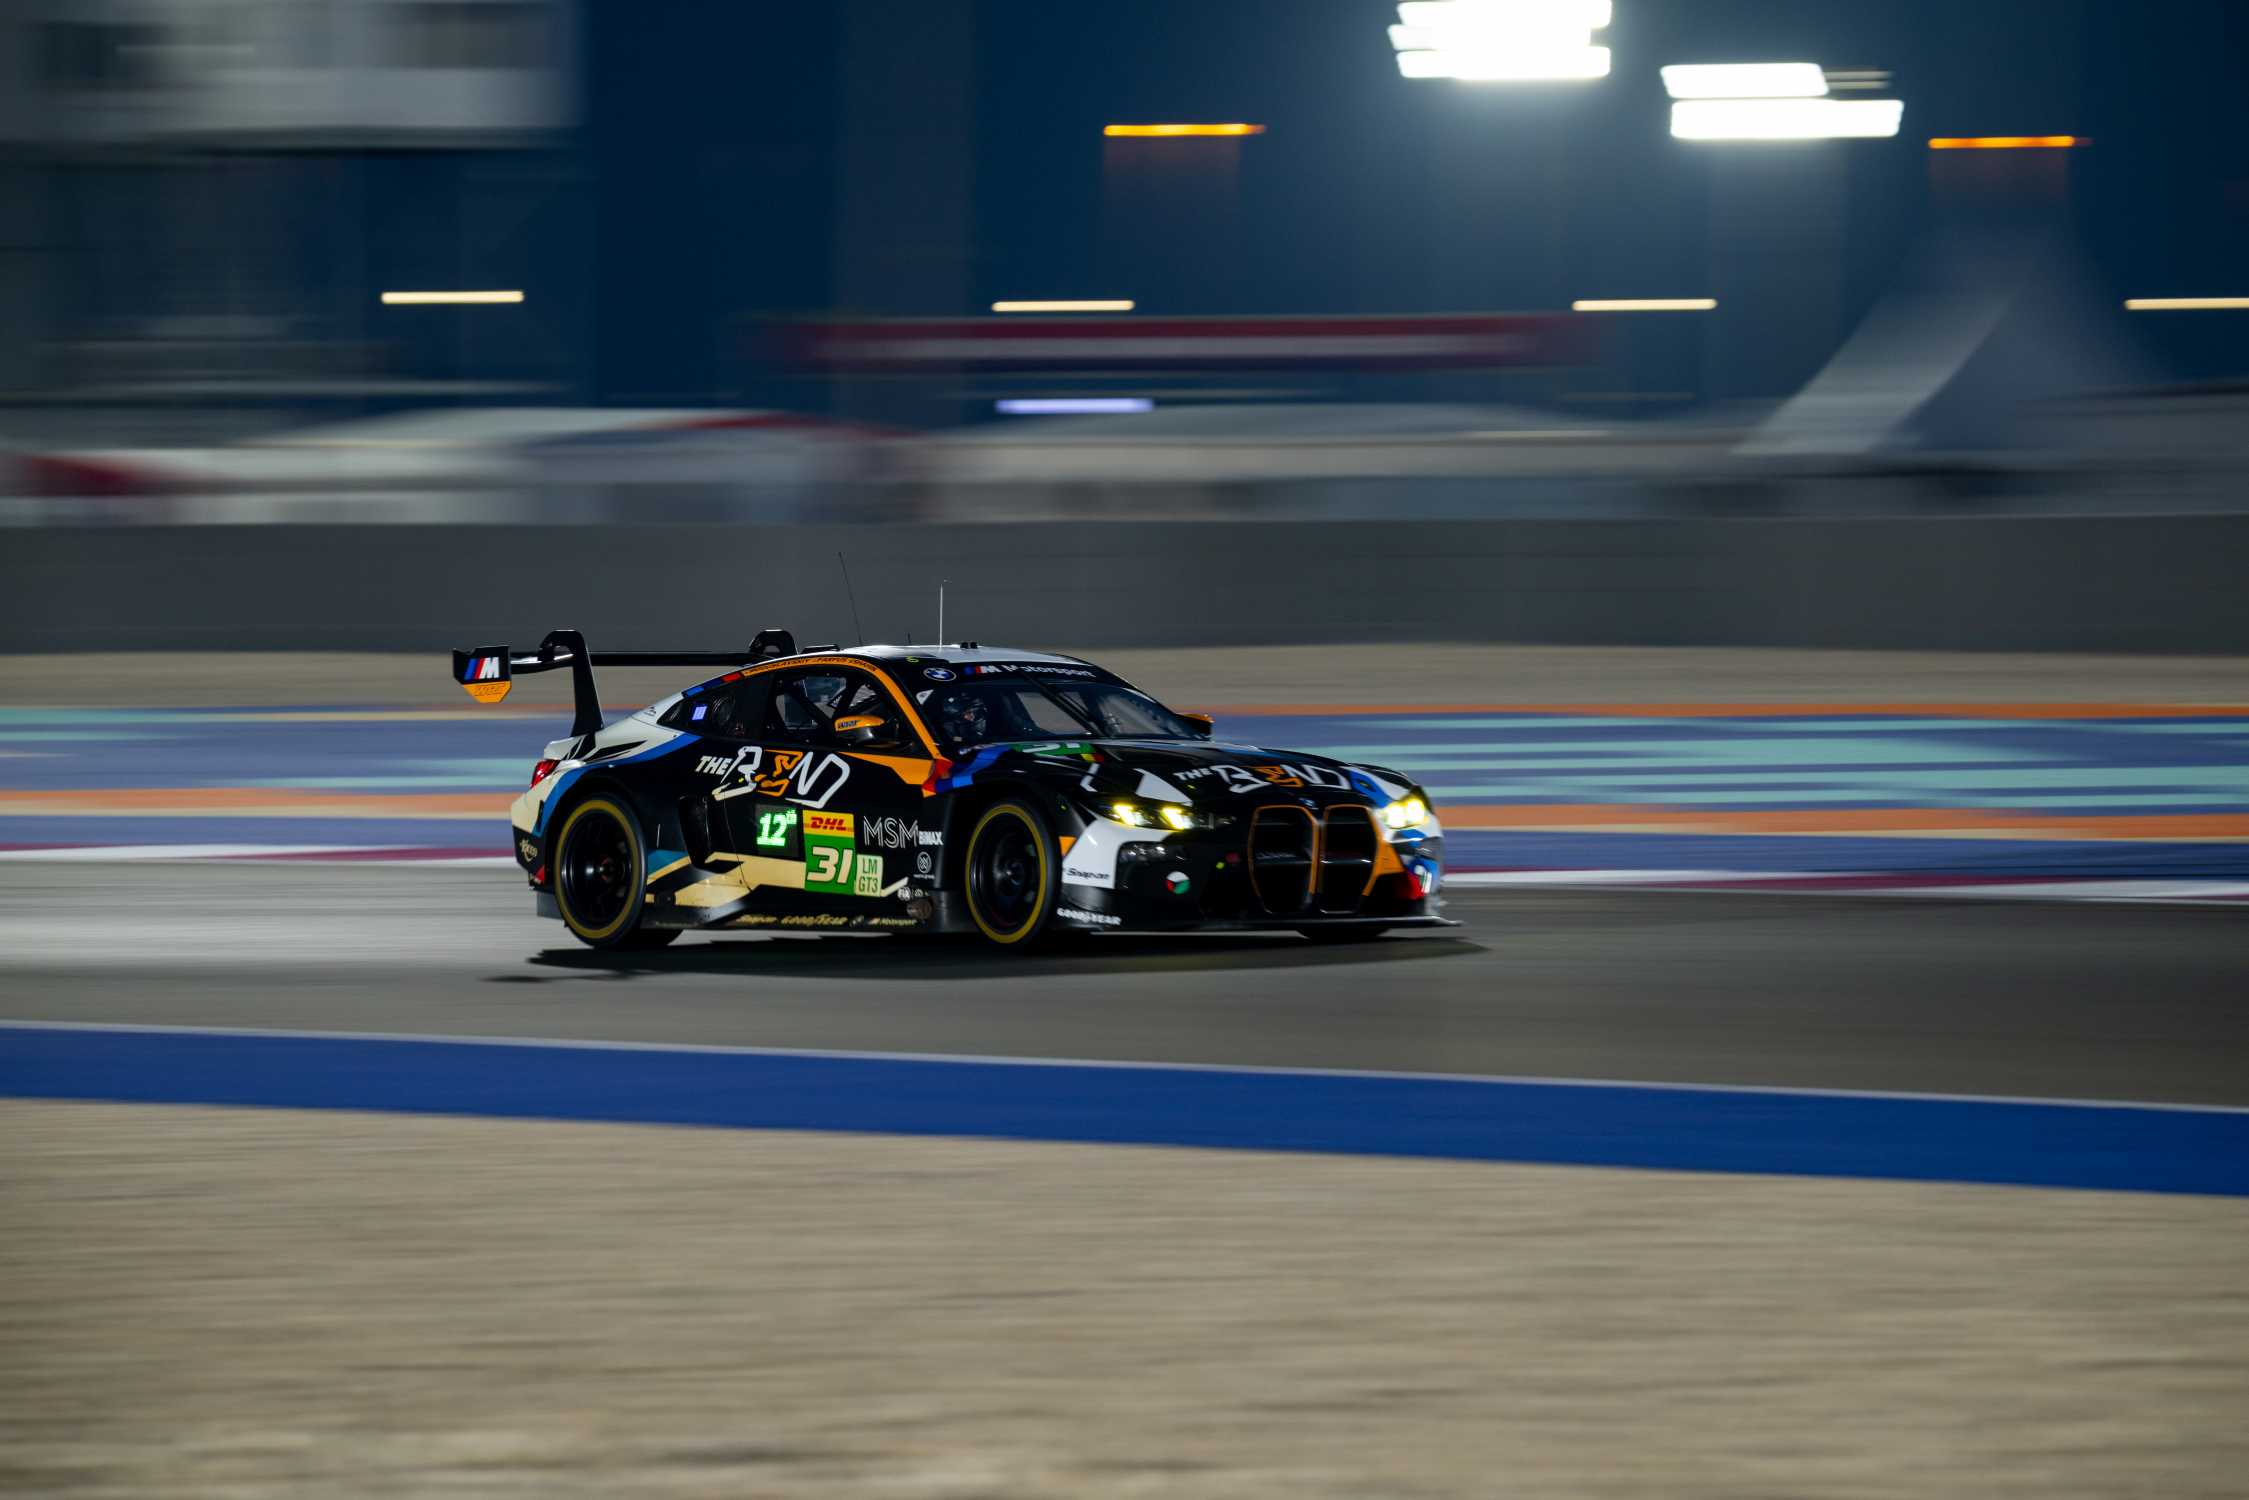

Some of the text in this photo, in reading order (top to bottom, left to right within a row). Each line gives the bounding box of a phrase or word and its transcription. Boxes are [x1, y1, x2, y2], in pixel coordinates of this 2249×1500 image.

[475, 656, 500, 679] M
[695, 755, 733, 775] THE
[1173, 766, 1213, 781] THE
[810, 816, 847, 831] DHL
[863, 815, 919, 849] MSM
[806, 846, 854, 884] 31
[861, 857, 878, 873] LM
[858, 876, 879, 893] GT3
[1056, 907, 1122, 926] GOODYEAR
